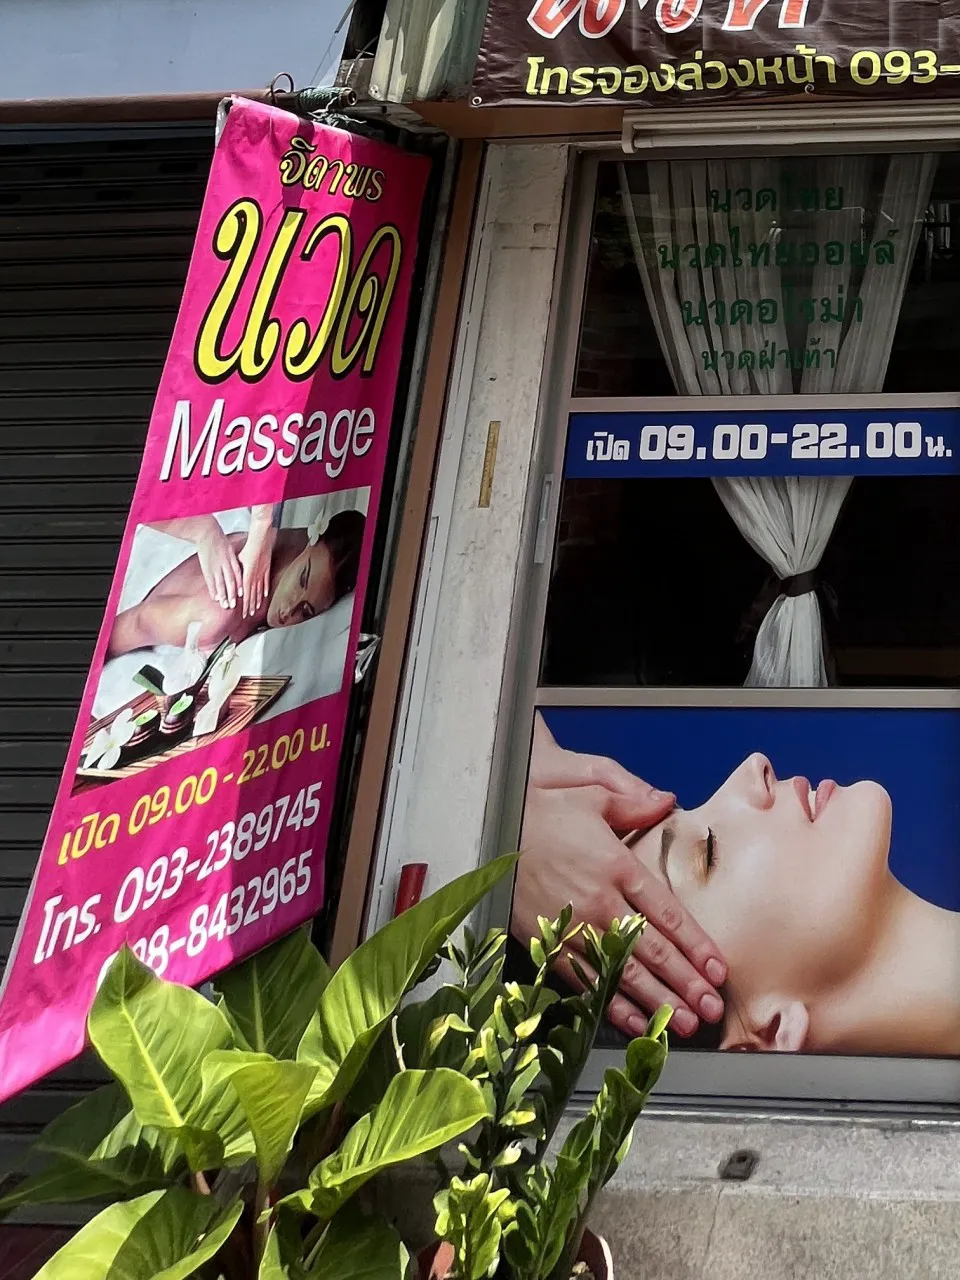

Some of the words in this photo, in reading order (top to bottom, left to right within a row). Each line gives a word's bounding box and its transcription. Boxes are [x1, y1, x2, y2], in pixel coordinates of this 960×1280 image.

[524, 44, 836, 96] โทรจองล่วงหน้า
[279, 135, 386, 202] จิดาพร
[193, 196, 402, 384] นวด
[158, 398, 376, 483] Massage
[585, 430, 631, 462] เปิด
[33, 894, 101, 965] โทร.
[112, 780, 323, 926] 093-2389745
[57, 812, 121, 866] เปิด
